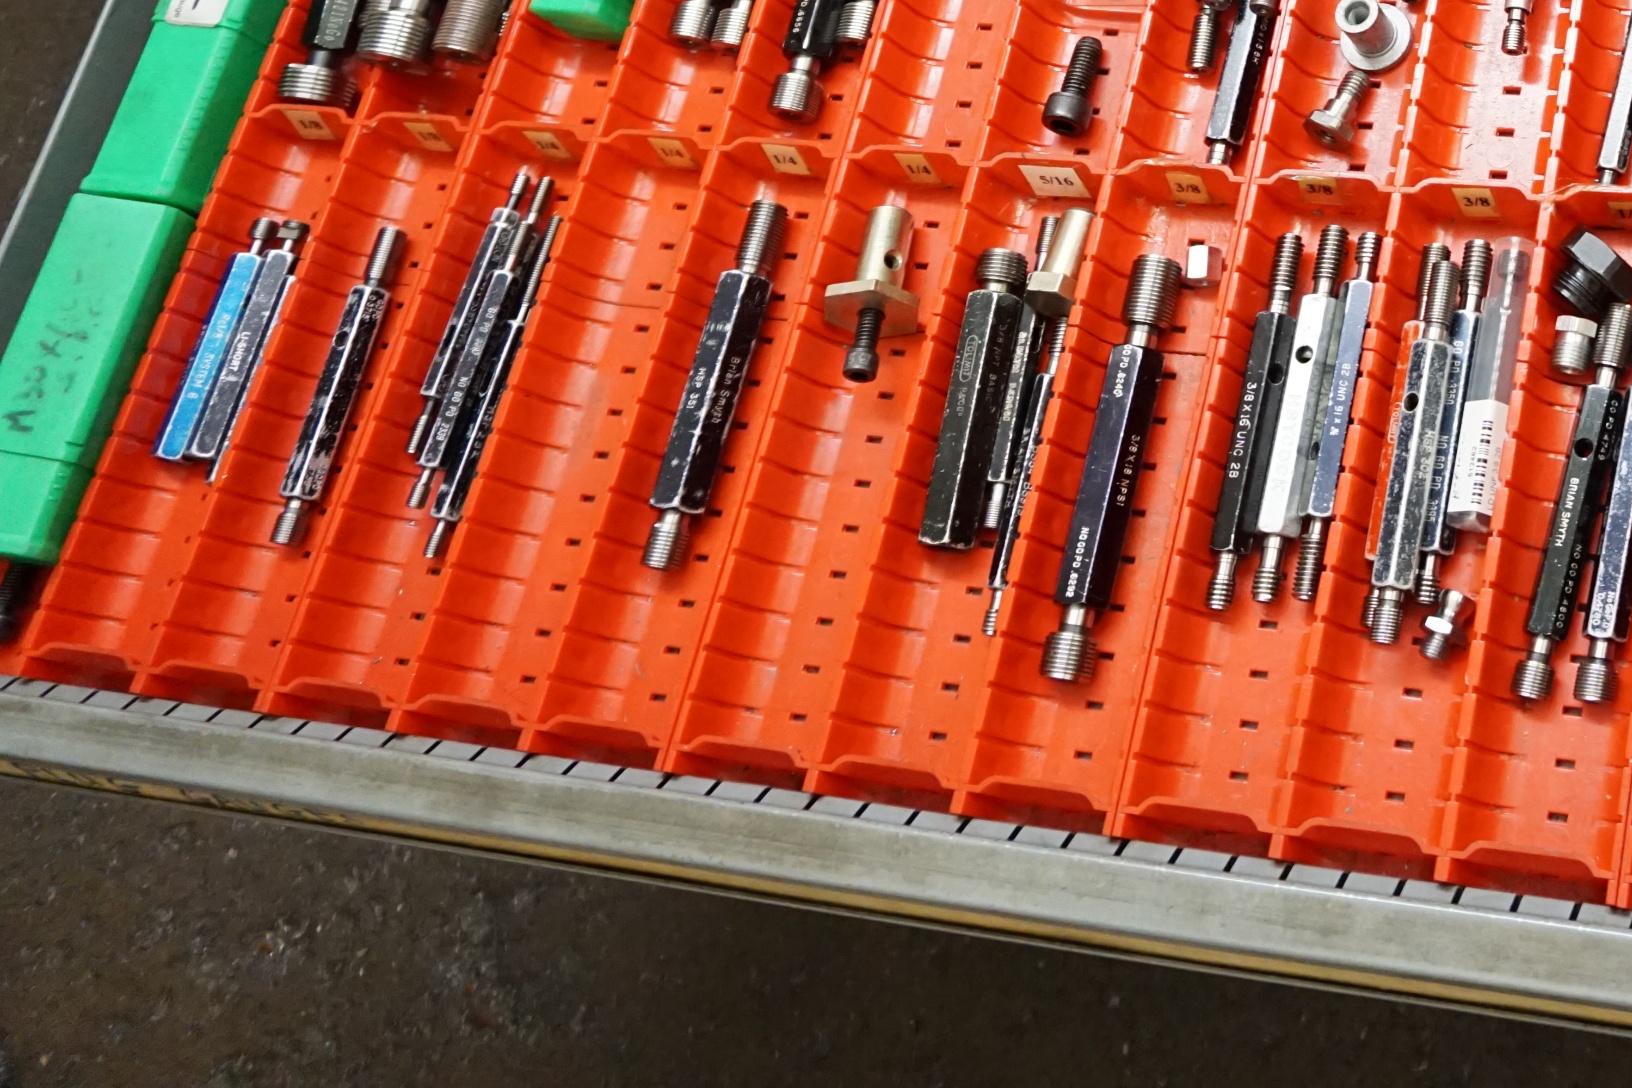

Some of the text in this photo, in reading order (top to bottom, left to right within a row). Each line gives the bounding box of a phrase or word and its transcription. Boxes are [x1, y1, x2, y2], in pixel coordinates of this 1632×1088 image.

[773, 154, 797, 166] 1/4
[907, 164, 931, 175] 1/4
[1039, 174, 1074, 186] 5/16
[1175, 182, 1201, 194] 3/8
[1307, 184, 1333, 195] 3/8
[1463, 196, 1491, 207] 3/8
[692, 365, 706, 388] HSP
[1339, 361, 1351, 376] 2B
[707, 356, 740, 425] Brian Smyth
[1335, 379, 1348, 400] UNC
[1333, 404, 1343, 415] 16
[1228, 381, 1257, 479] 3/8 X 16 UNC 2B
[1128, 433, 1140, 453] 3/8
[1422, 429, 1436, 452] HSP
[1122, 463, 1134, 475] 18
[1554, 476, 1579, 548] BRIAN SMYTH
[1572, 543, 1583, 560] NO
[1567, 562, 1579, 578] GO
[1563, 578, 1575, 594] PD
